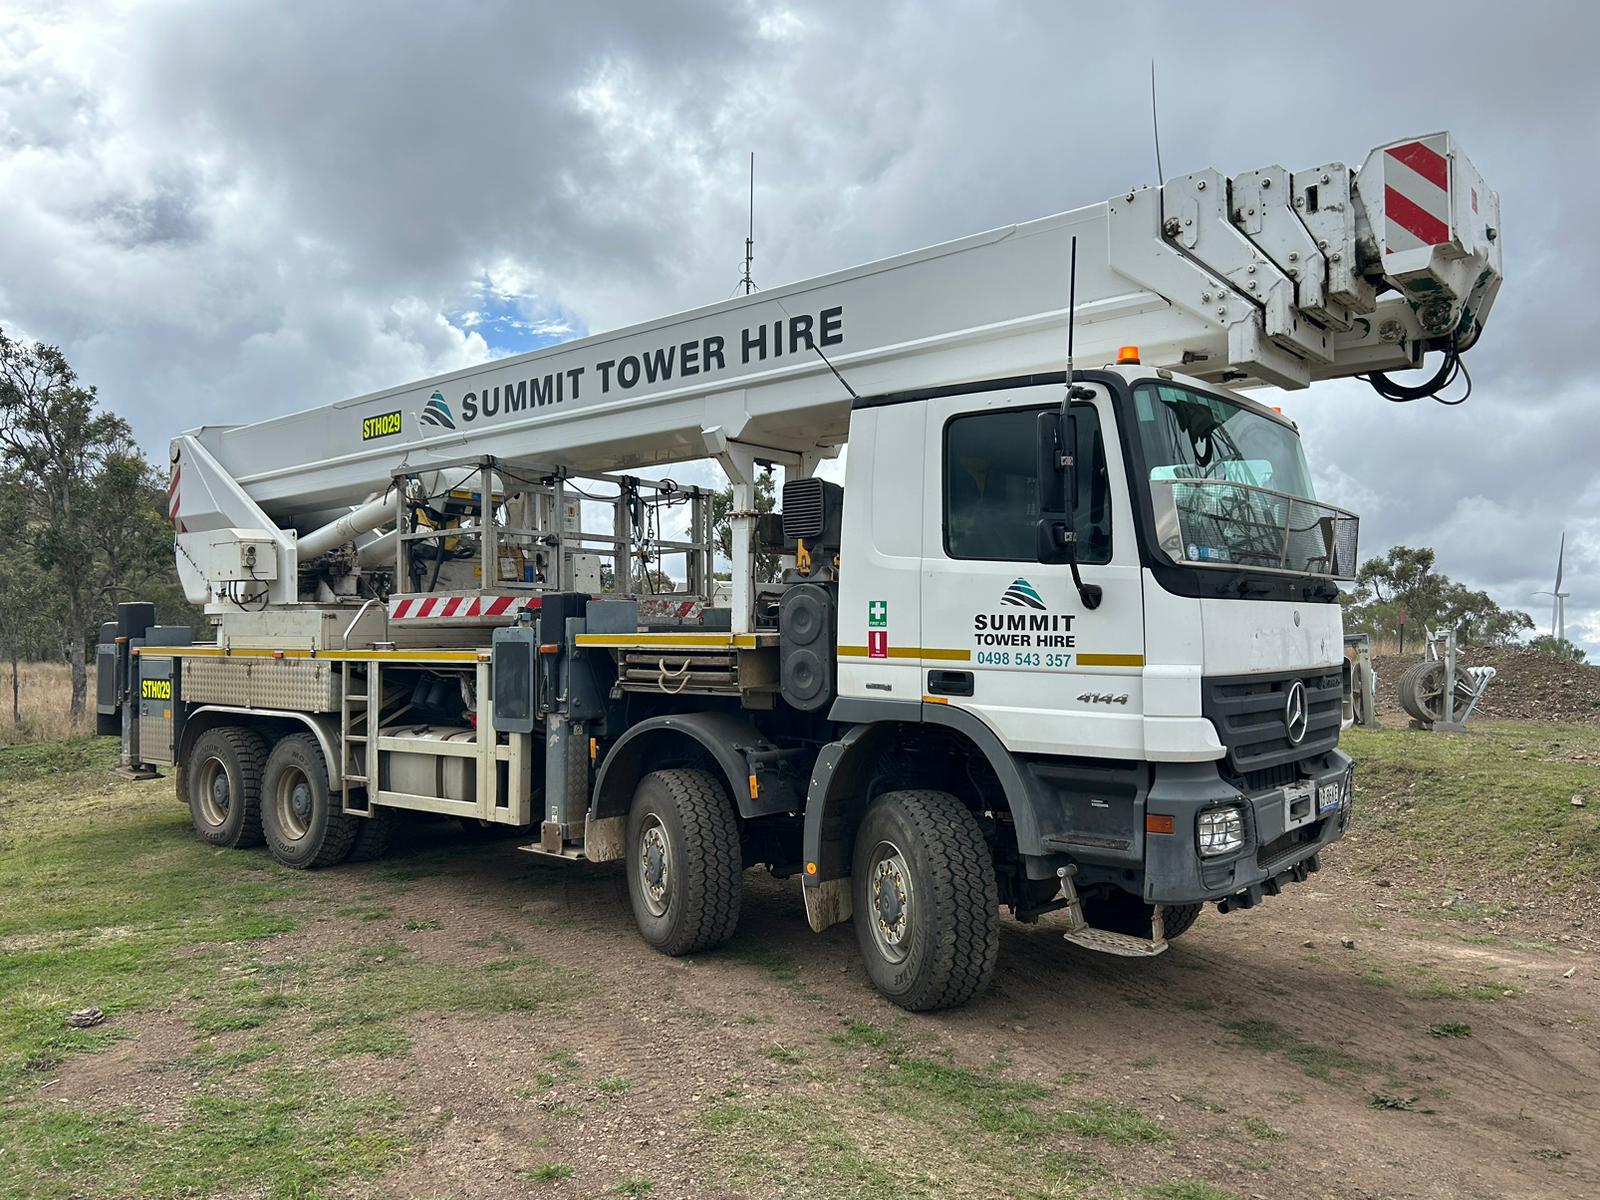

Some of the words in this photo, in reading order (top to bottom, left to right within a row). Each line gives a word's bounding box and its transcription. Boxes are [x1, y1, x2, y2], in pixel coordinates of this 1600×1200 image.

[462, 368, 584, 421] SUMMIT
[596, 335, 726, 393] TOWER
[741, 306, 843, 364] HIRE
[364, 413, 400, 438] STH029
[974, 614, 1075, 631] SUMMIT
[974, 634, 1031, 646] TOWER
[1036, 635, 1075, 647] HIRE
[977, 651, 1010, 665] 0498
[1015, 653, 1040, 666] 543
[1046, 654, 1072, 667] 357
[142, 680, 171, 699] STH029
[1076, 692, 1129, 705] 4144
